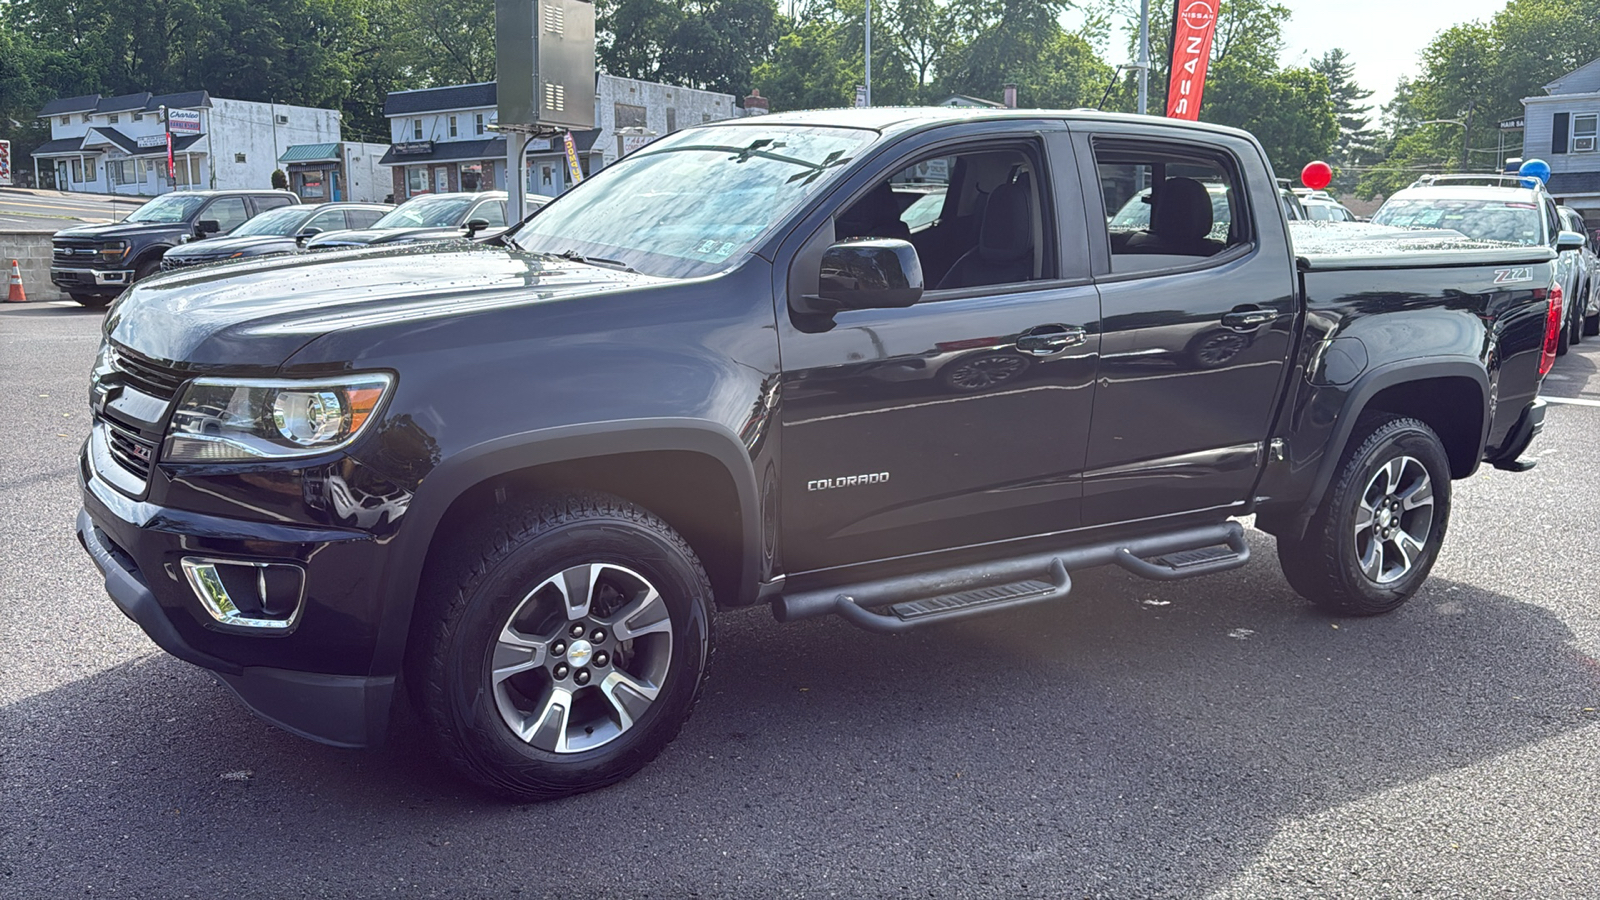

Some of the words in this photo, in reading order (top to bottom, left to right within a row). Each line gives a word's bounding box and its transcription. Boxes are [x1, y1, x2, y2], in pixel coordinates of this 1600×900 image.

[1493, 266, 1534, 285] Z71
[134, 445, 151, 461] Z71
[807, 471, 890, 492] COLORADO
